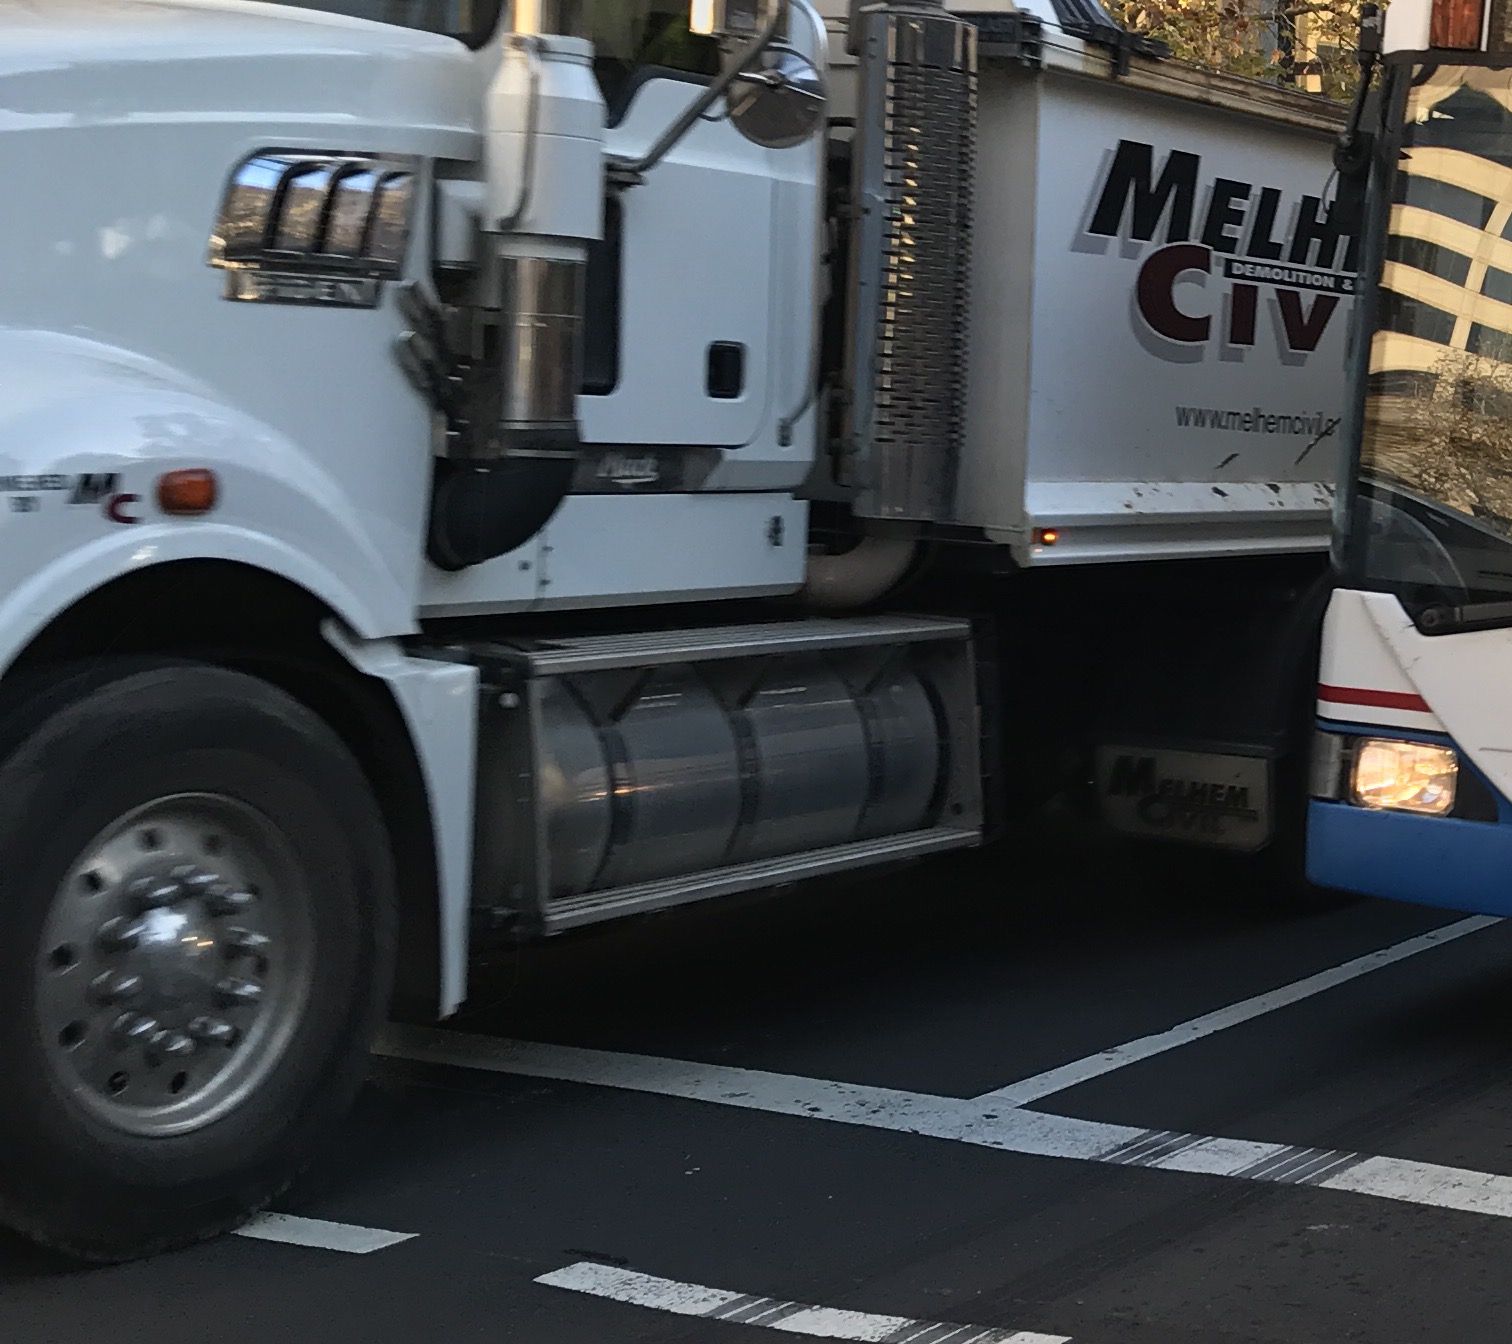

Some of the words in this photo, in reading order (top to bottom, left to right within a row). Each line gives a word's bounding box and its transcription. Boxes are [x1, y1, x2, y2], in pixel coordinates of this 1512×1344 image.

[1137, 243, 1341, 353] CIV
[1230, 262, 1335, 289] DEMOLITION
[1341, 280, 1354, 291] &
